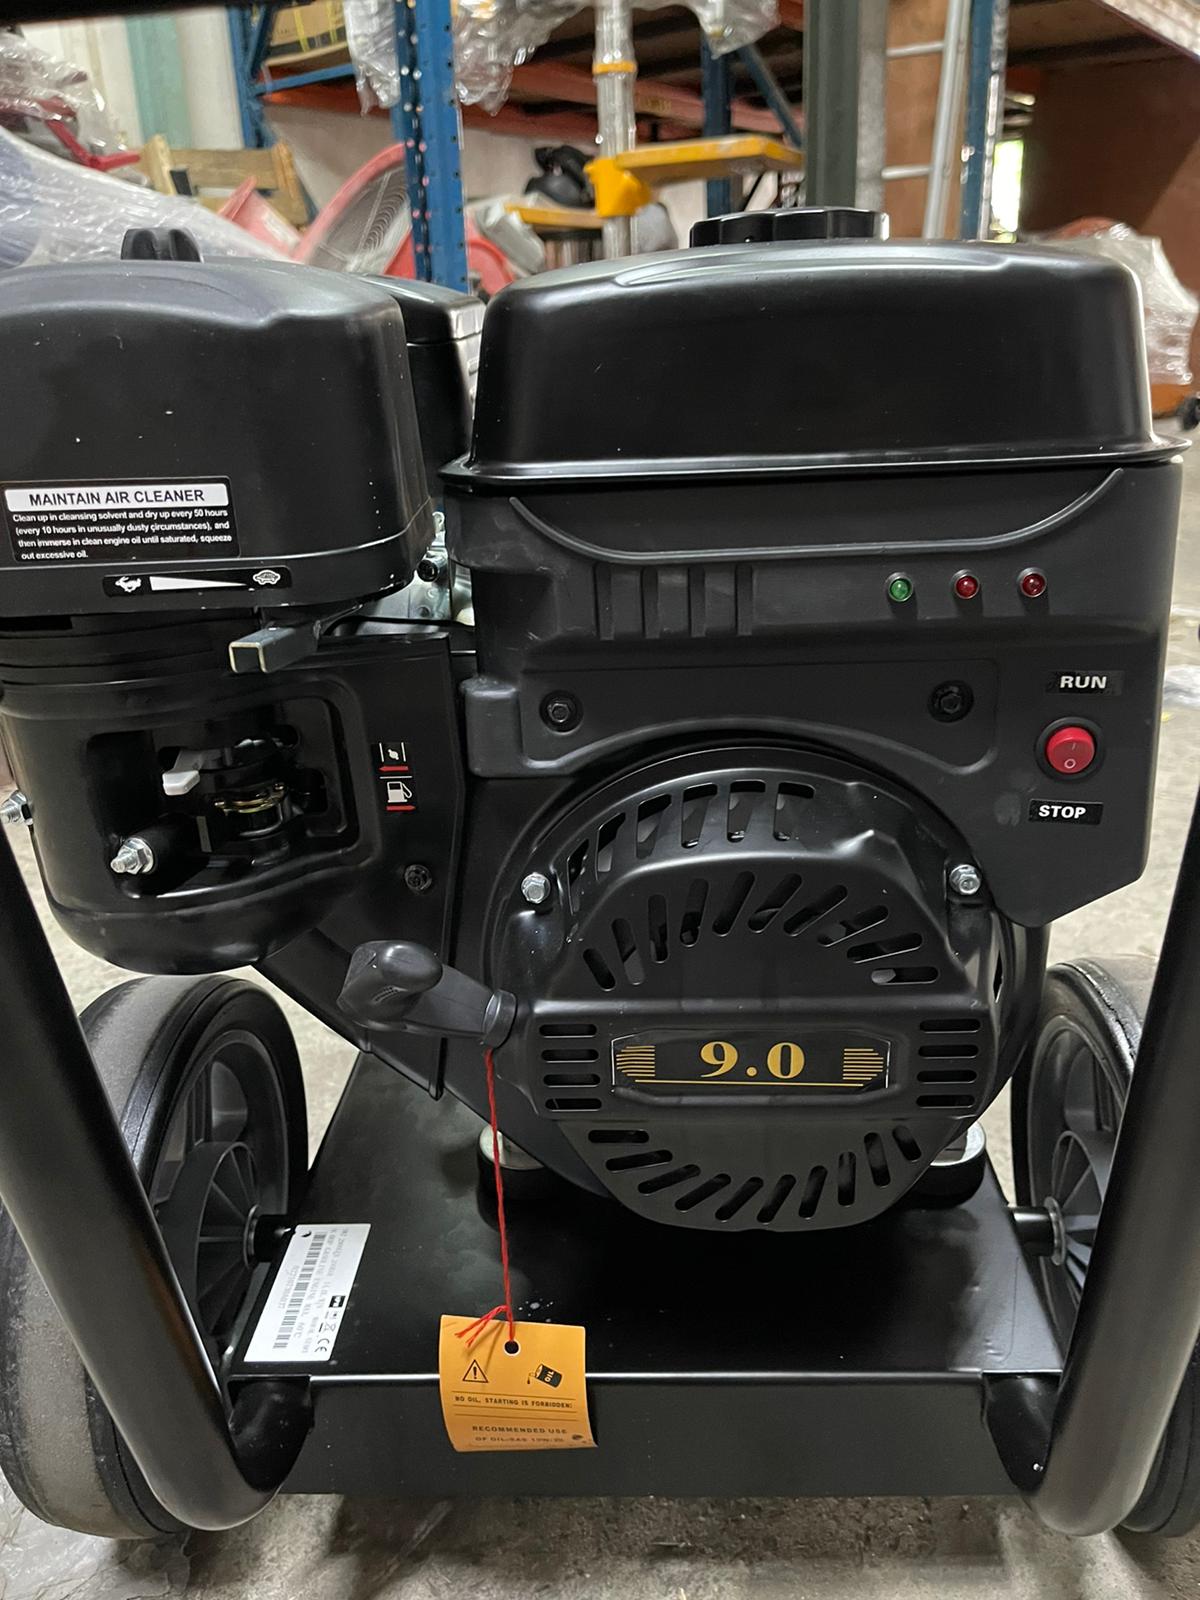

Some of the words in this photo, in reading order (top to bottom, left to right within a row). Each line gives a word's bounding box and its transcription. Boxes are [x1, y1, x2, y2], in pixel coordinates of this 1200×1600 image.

[29, 491, 101, 506] MAINTAIN
[105, 491, 131, 504] AIR
[134, 489, 205, 503] CLEANER
[12, 514, 37, 522] Clean
[37, 514, 49, 523] up
[49, 513, 58, 521] in
[58, 512, 97, 521] cleansing
[98, 511, 128, 520] solvent
[128, 510, 144, 519] and
[144, 510, 158, 520] dry
[159, 511, 171, 520] up
[171, 510, 193, 520] every
[193, 509, 204, 517] 50
[205, 508, 229, 517] hours
[15, 527, 41, 536] (every
[41, 526, 52, 534] 10
[53, 525, 77, 534] hours
[77, 525, 86, 533] in
[87, 523, 126, 533] unusually
[126, 522, 150, 533] dusty
[213, 520, 231, 530] and
[18, 539, 37, 548] then
[37, 538, 72, 547] immerse
[72, 537, 81, 546] in
[81, 536, 103, 546] clean
[103, 536, 131, 547] engine
[130, 535, 141, 545] oil
[141, 534, 160, 544] until
[160, 533, 200, 544] saturated,
[200, 534, 233, 544] squeeze
[20, 551, 36, 560] out
[35, 550, 77, 560] excessive
[76, 549, 90, 559] oil.
[1060, 675, 1108, 690] RUN
[1038, 804, 1087, 820] STOP
[700, 1040, 806, 1080] 9.0
[544, 1370, 555, 1383] OIL
[485, 1397, 519, 1406] STARTING
[472, 1426, 546, 1434] RECOMMENDED
